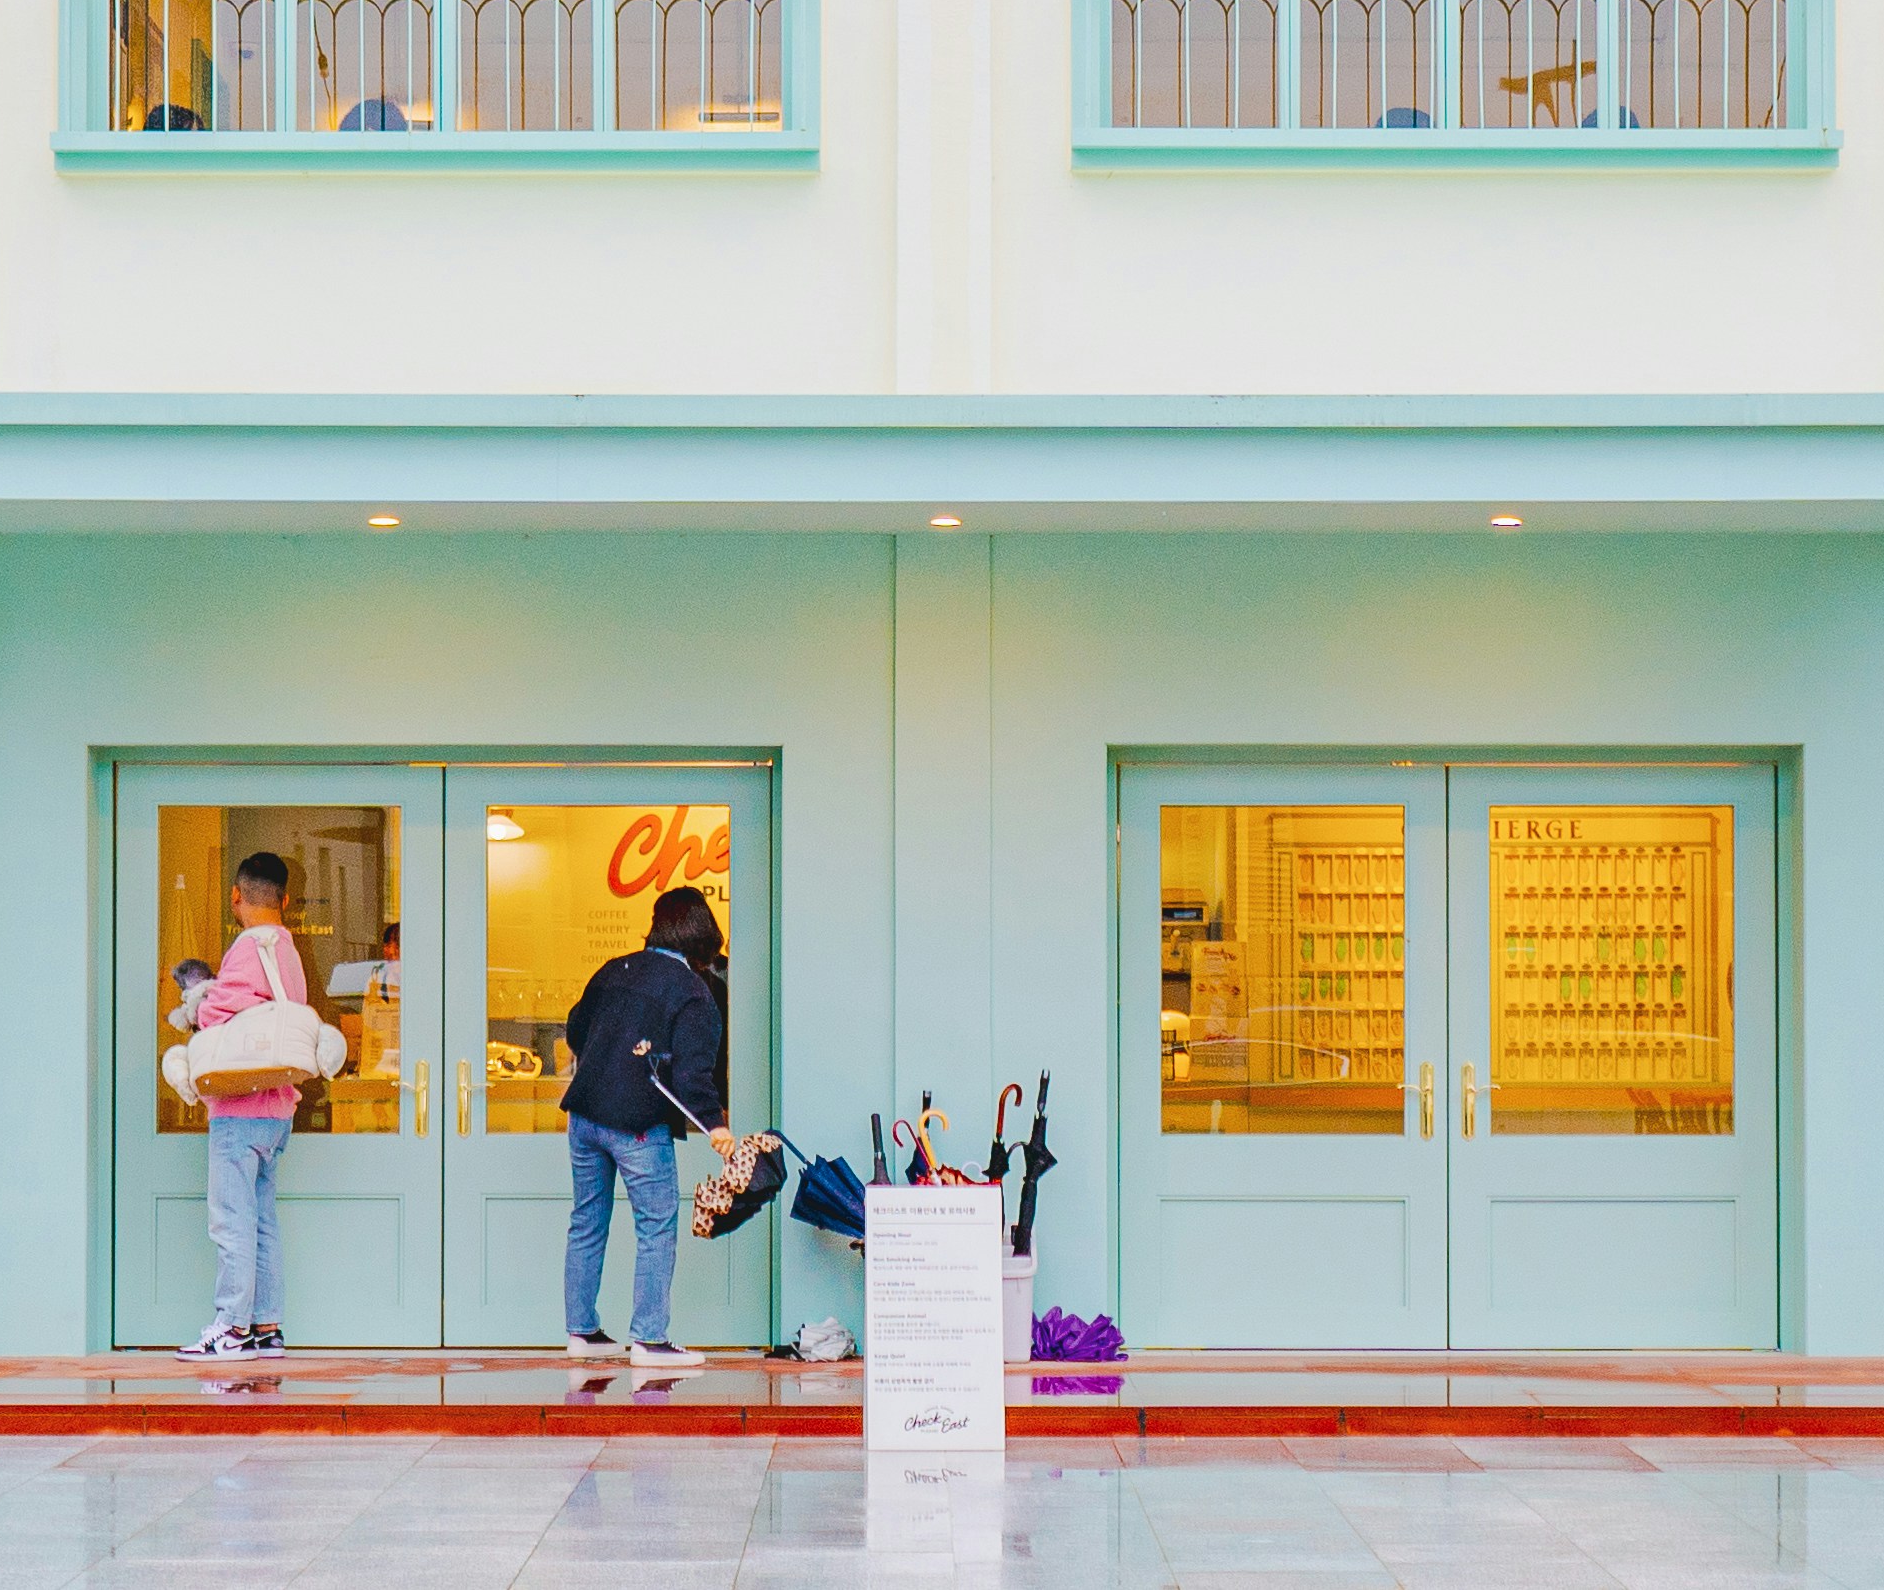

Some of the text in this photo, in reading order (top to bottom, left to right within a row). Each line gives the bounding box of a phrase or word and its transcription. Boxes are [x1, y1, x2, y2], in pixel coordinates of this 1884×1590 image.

[588, 910, 628, 919] COFFEE
[587, 925, 630, 934] BAKERY
[588, 940, 629, 949] TRAVEL
[904, 1411, 971, 1434] Check East
